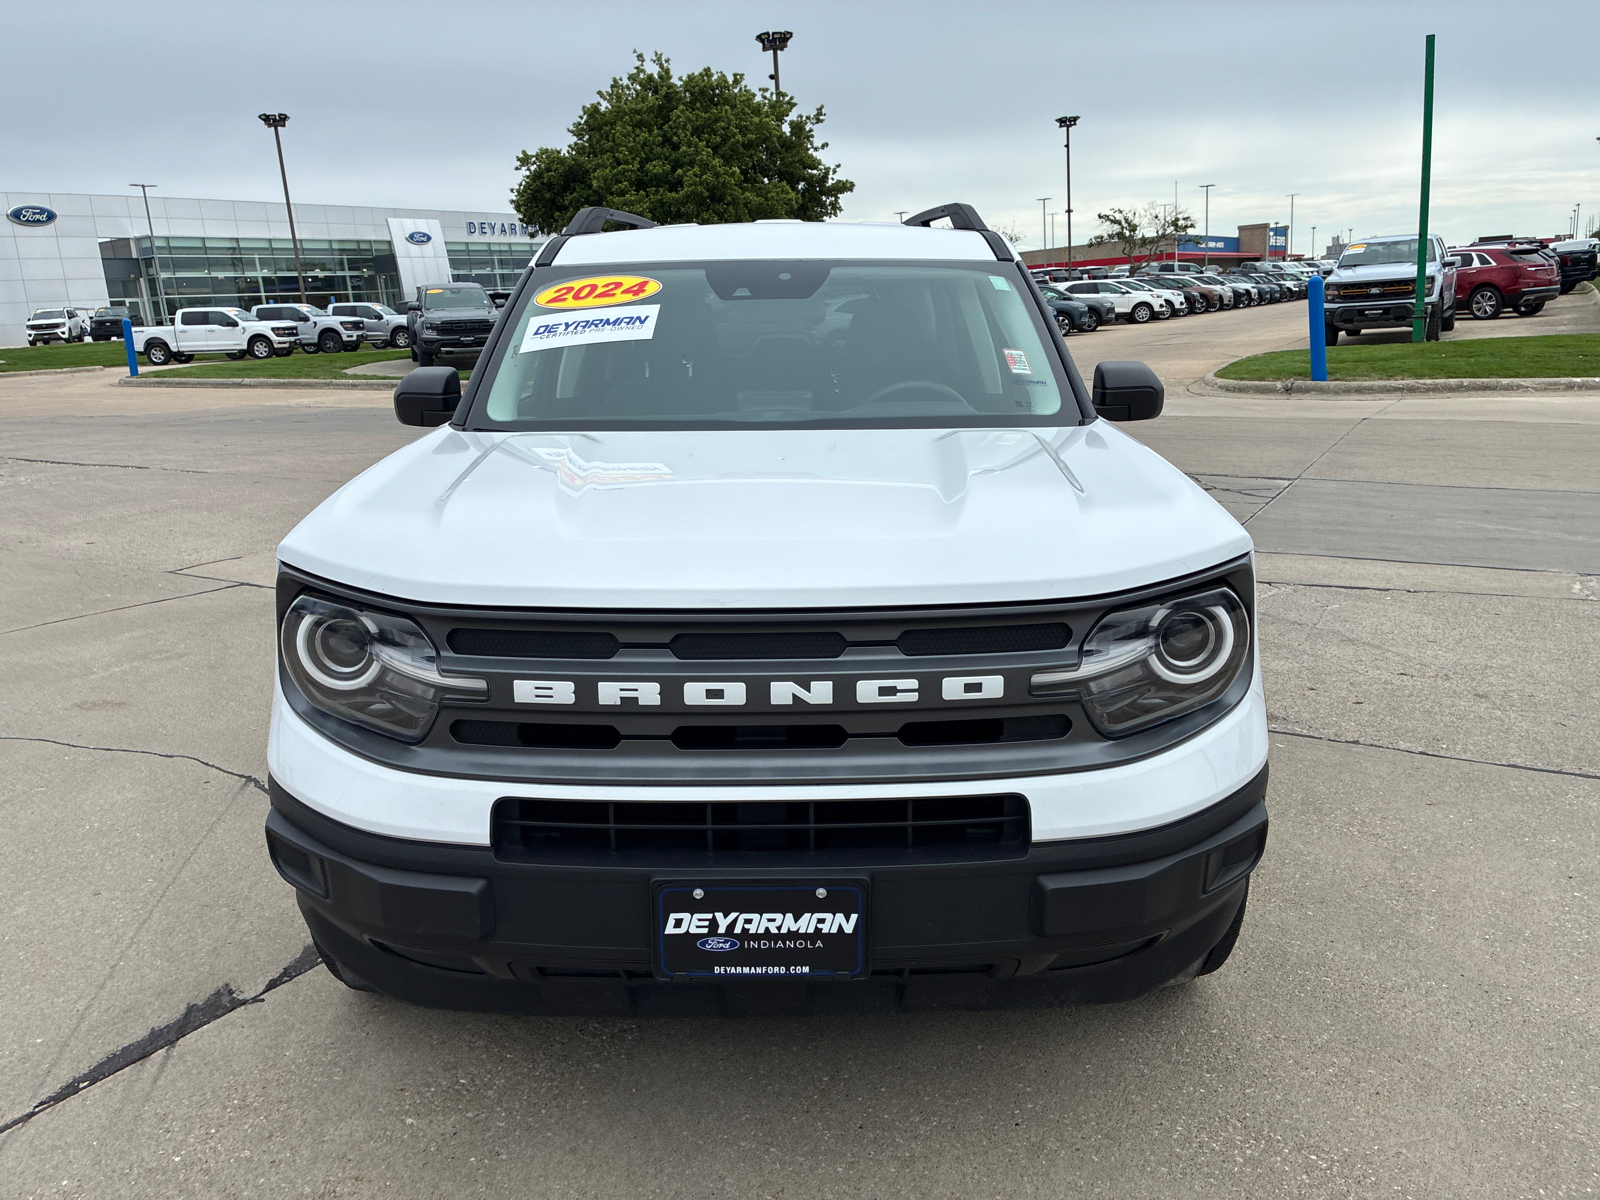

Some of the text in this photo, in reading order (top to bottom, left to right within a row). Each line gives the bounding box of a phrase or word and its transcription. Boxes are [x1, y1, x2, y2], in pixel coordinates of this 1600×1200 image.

[20, 208, 48, 221] Ford
[468, 221, 547, 236] DEYARM
[412, 232, 428, 242] Ford
[545, 280, 650, 304] 2024
[532, 315, 650, 336] DEYARMAN
[539, 324, 644, 339] CERTIFIED PRE-OWNED
[513, 675, 1004, 706] BRONCO
[664, 912, 858, 934] DEYARMAN
[705, 938, 824, 949] Ford INDIANOLA
[714, 966, 810, 974] DEYARMANFORD.COM
